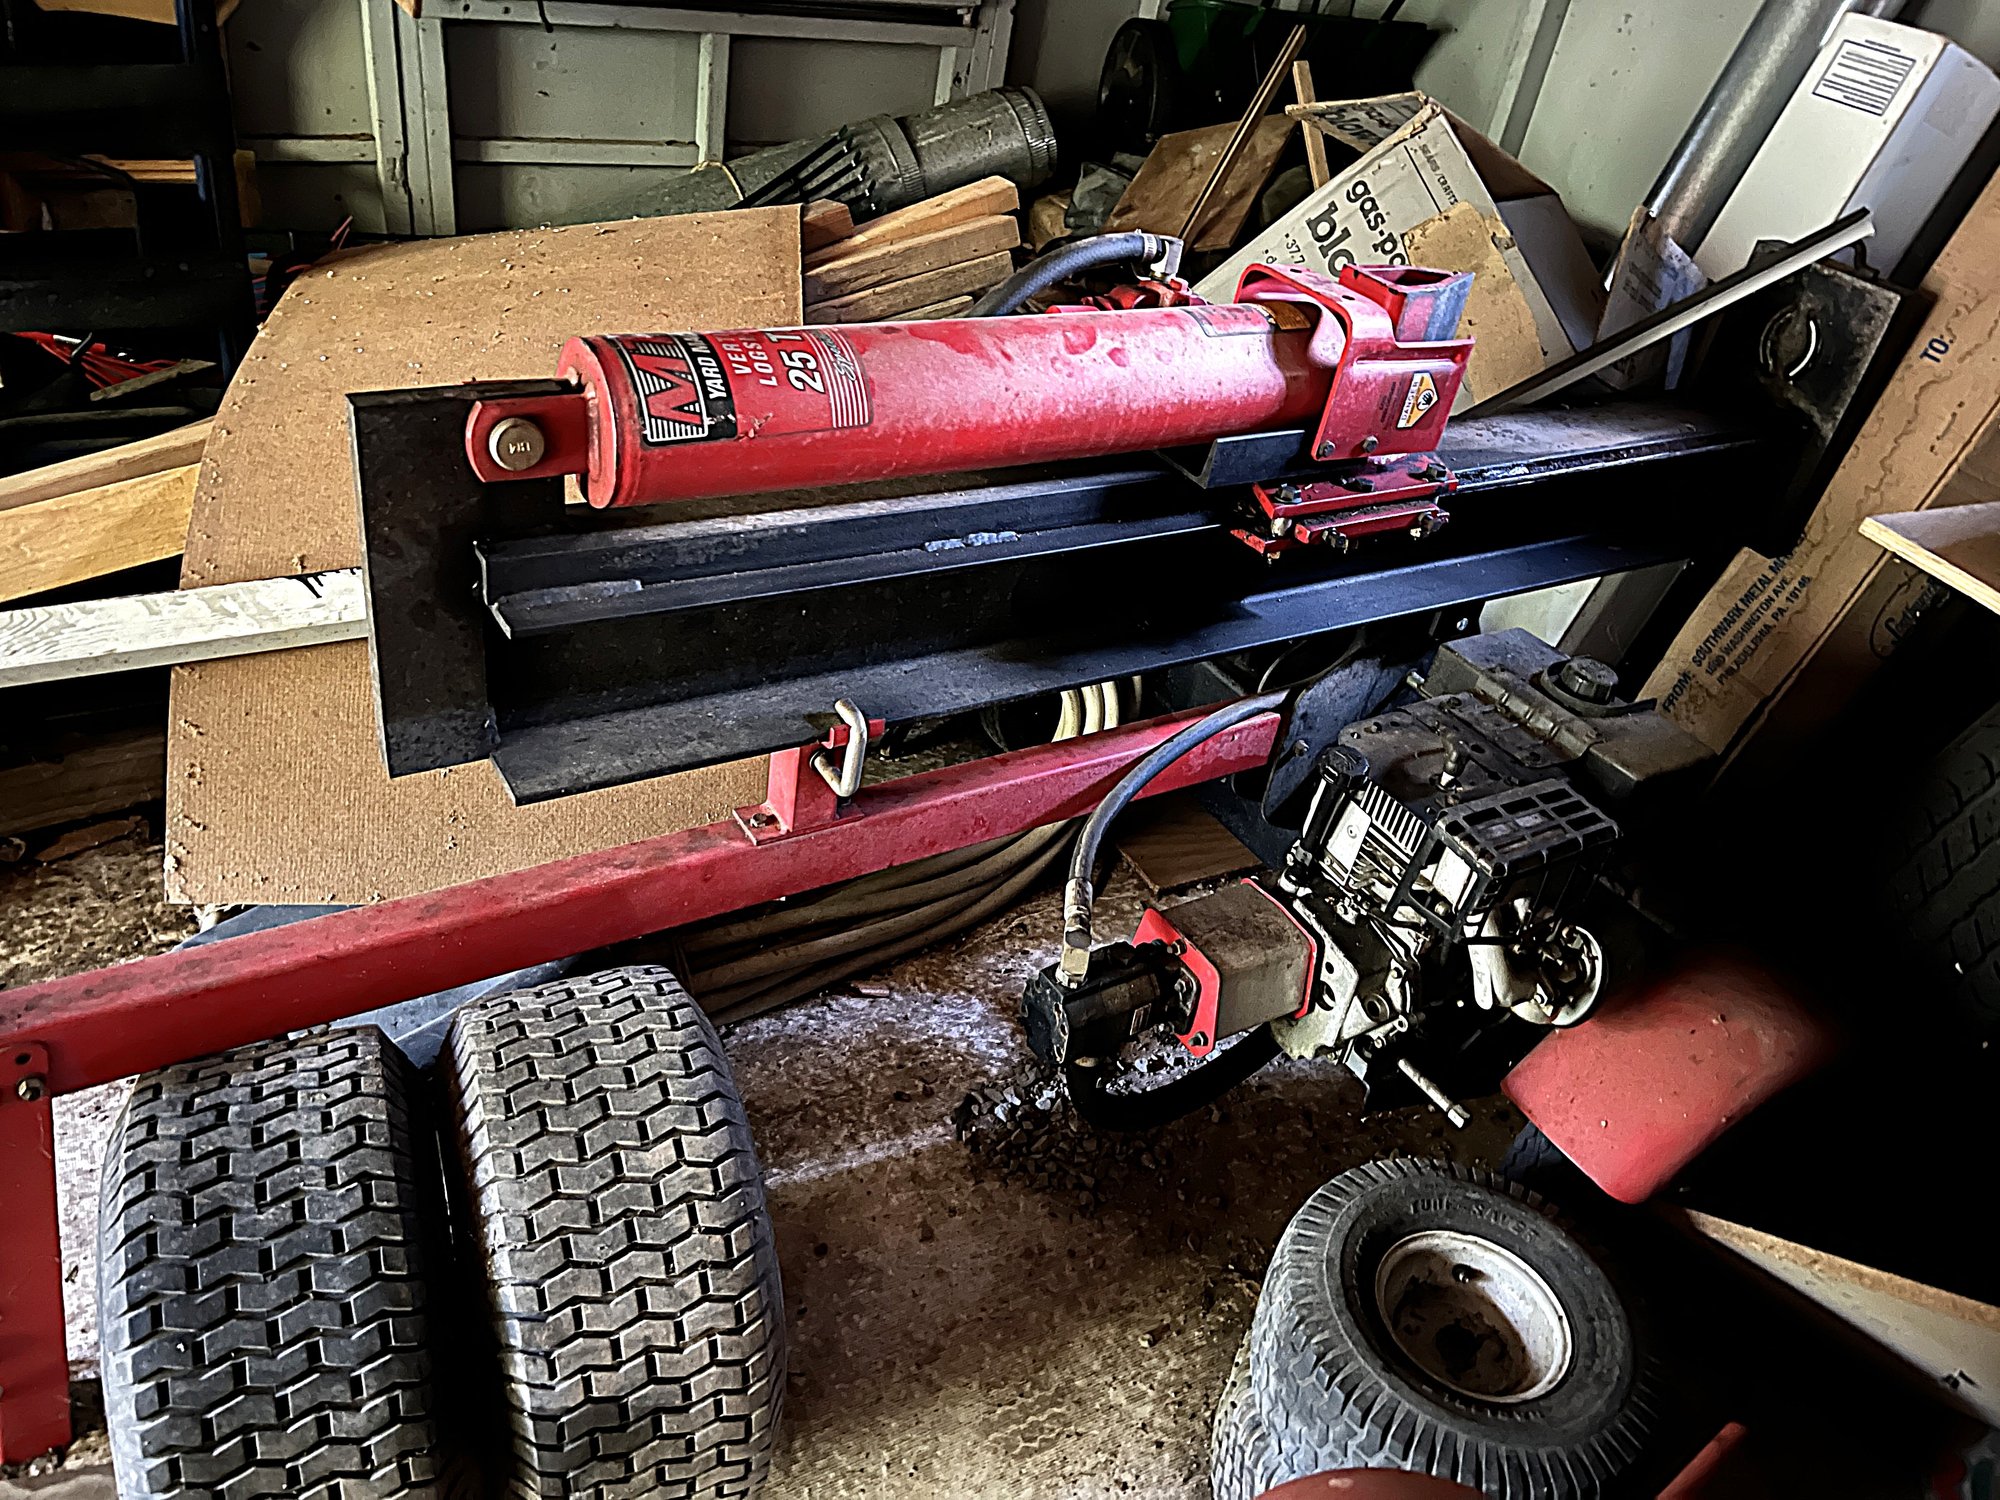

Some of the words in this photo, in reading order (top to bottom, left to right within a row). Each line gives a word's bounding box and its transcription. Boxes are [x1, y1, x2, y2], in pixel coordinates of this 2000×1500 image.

[1919, 333, 1954, 363] TO:
[699, 356, 727, 399] YARD
[778, 350, 826, 393] 25
[1401, 381, 1418, 421] DANGER
[1661, 669, 1696, 713] FROM:
[1692, 604, 1745, 668] SOUTHWARK
[1738, 573, 1774, 610] METAL
[1720, 596, 1776, 656] WASHINGTON
